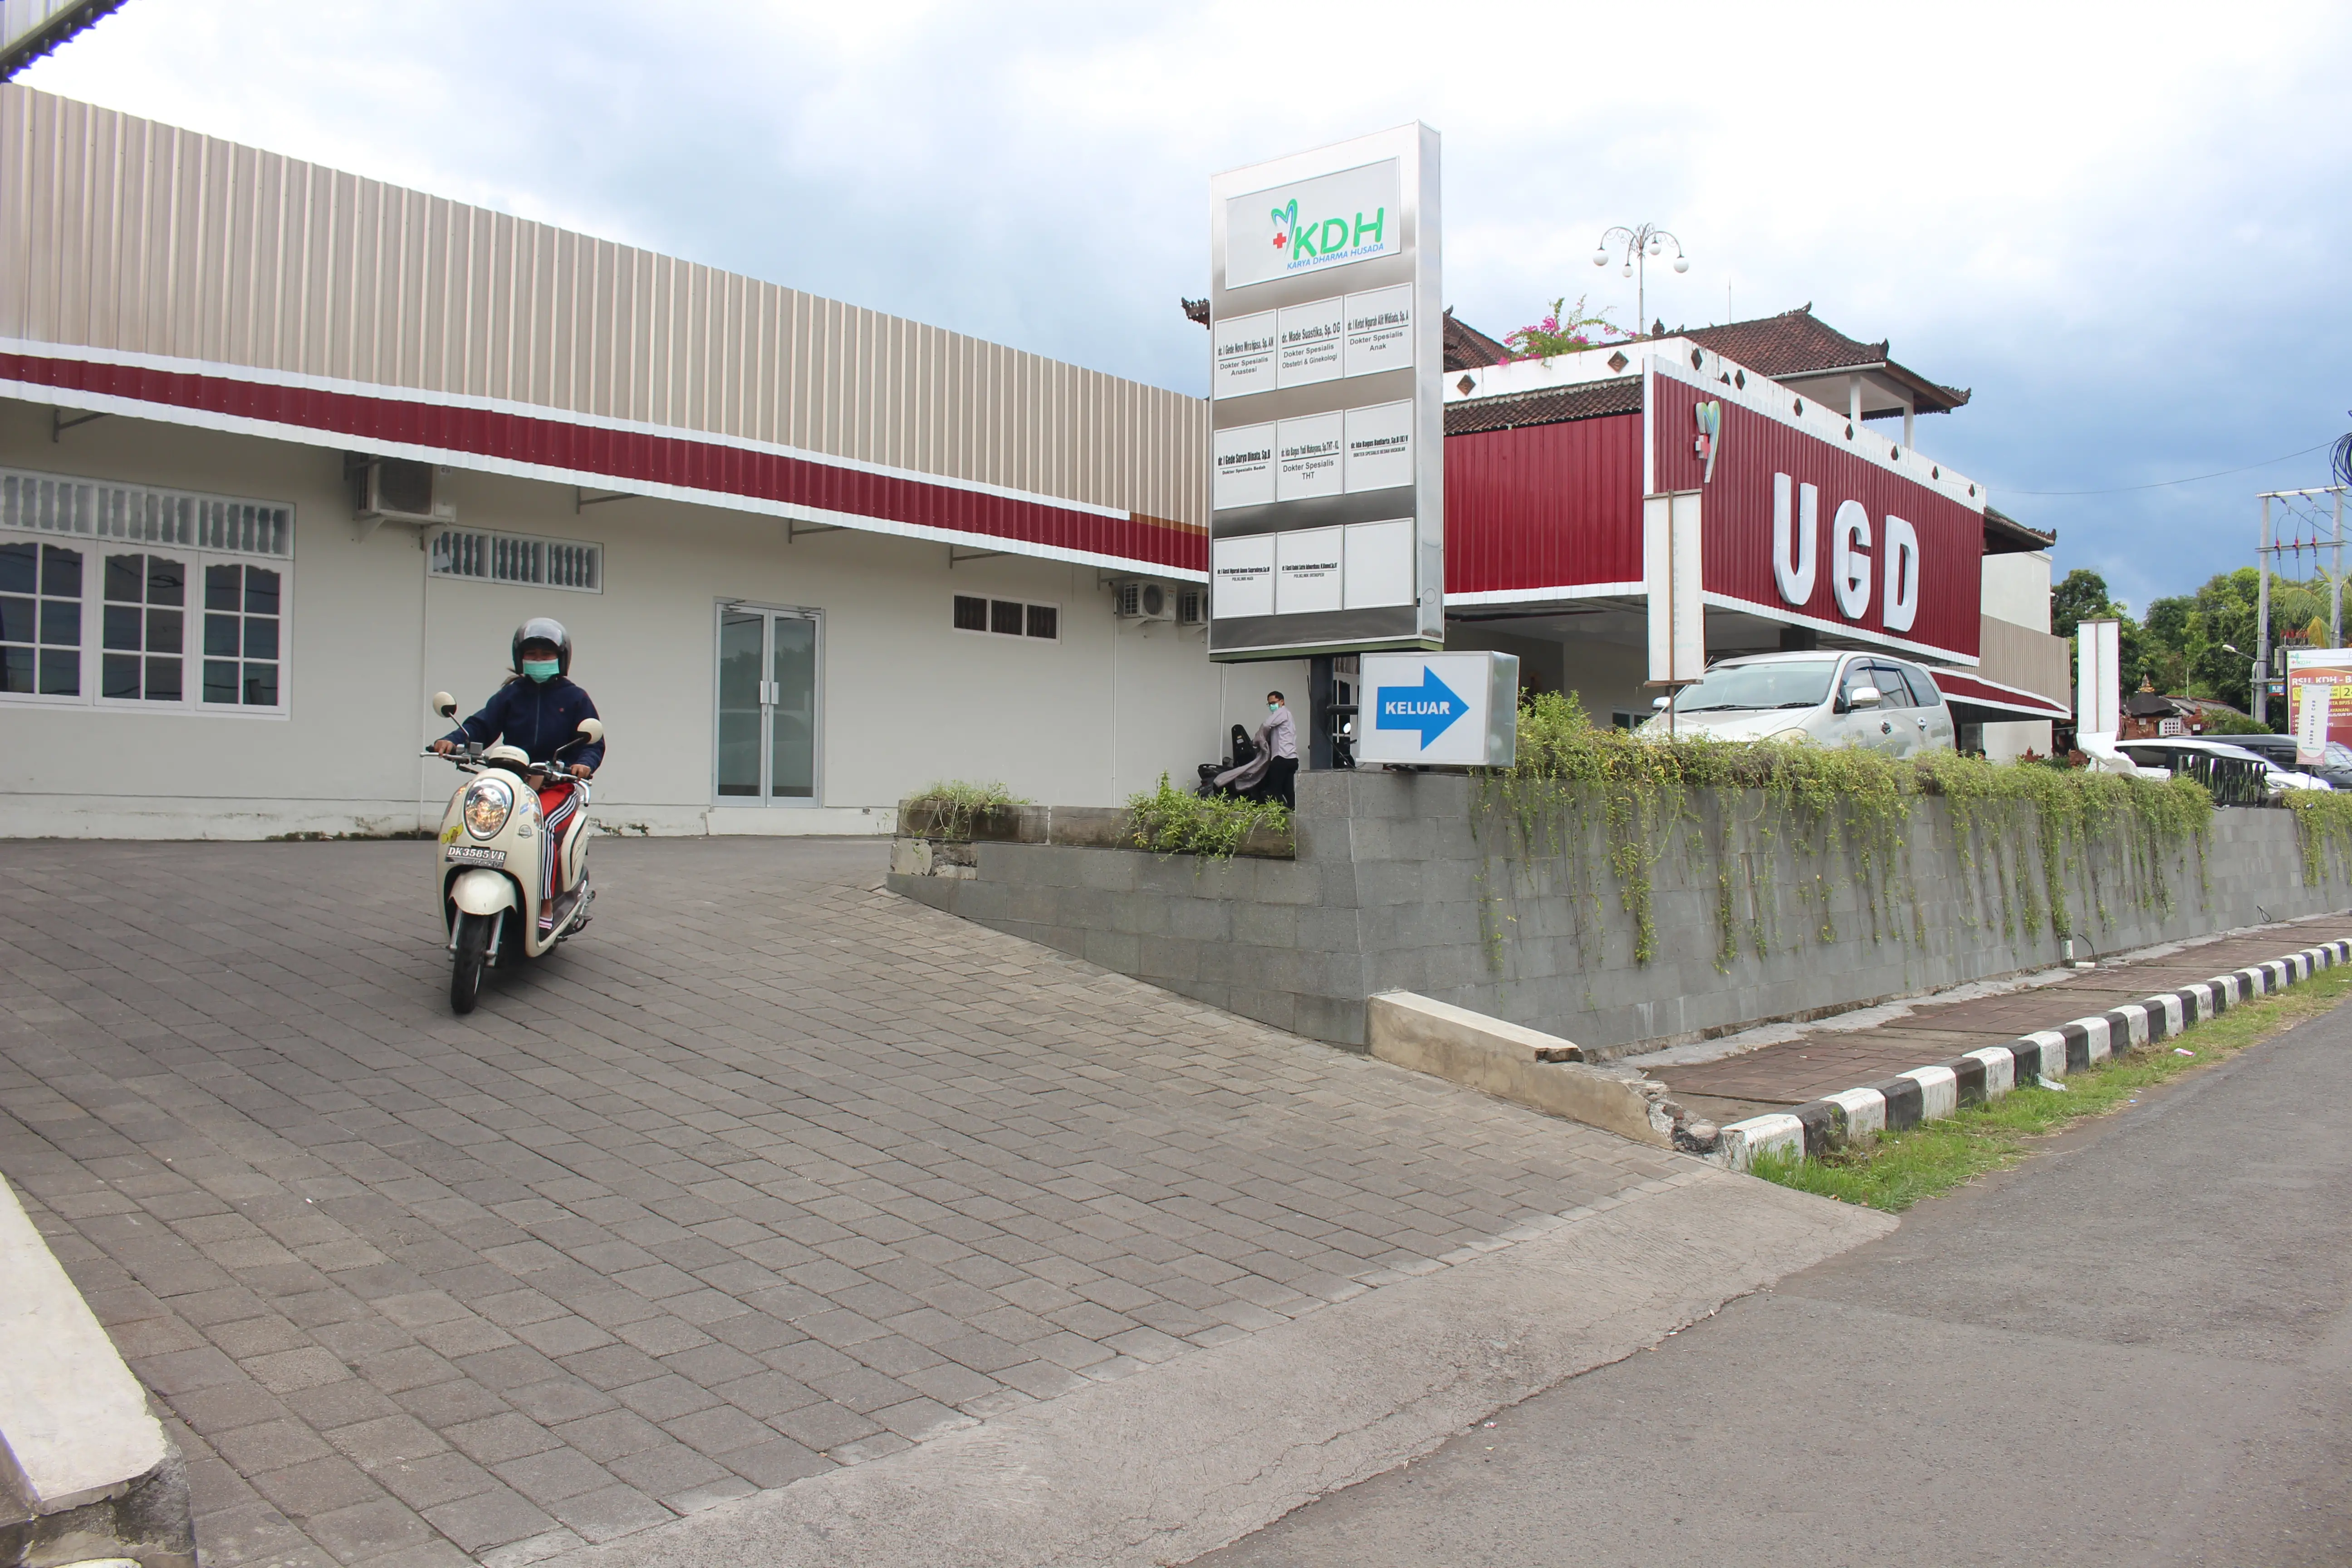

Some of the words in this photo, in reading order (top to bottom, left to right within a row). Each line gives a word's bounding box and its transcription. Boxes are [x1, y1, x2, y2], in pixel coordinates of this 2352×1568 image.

[1293, 207, 1384, 260] KDH
[1287, 258, 1310, 270] KARYA
[1313, 251, 1348, 265] DHARMA
[1350, 243, 1383, 257] HUSADA
[1289, 330, 1301, 342] Made
[1302, 327, 1323, 339] Suastika,
[1350, 337, 1372, 345] Dokter
[1373, 331, 1403, 342] Spesialis
[1225, 344, 1234, 355] Gede
[1269, 336, 1274, 347] AN
[1284, 349, 1304, 358] Dokter
[1306, 344, 1334, 355] Spesialis
[1369, 343, 1387, 352] Anak
[1241, 356, 1268, 367] Spesialis
[1282, 359, 1303, 368] Obstetri
[1309, 353, 1338, 364] Ginekologi
[1231, 366, 1257, 376] Anastesi
[1225, 454, 1235, 465] Gede
[1236, 453, 1247, 463] Surya
[1248, 451, 1261, 461] Dinata,
[1283, 464, 1304, 472] Dokter
[1305, 459, 1334, 470] Spesialis
[1302, 471, 1315, 480] THT
[1774, 472, 1919, 632] UGD
[2345, 675, 2352, 683] B
[2344, 687, 2352, 696] 2
[1385, 701, 1450, 715] KELUAR
